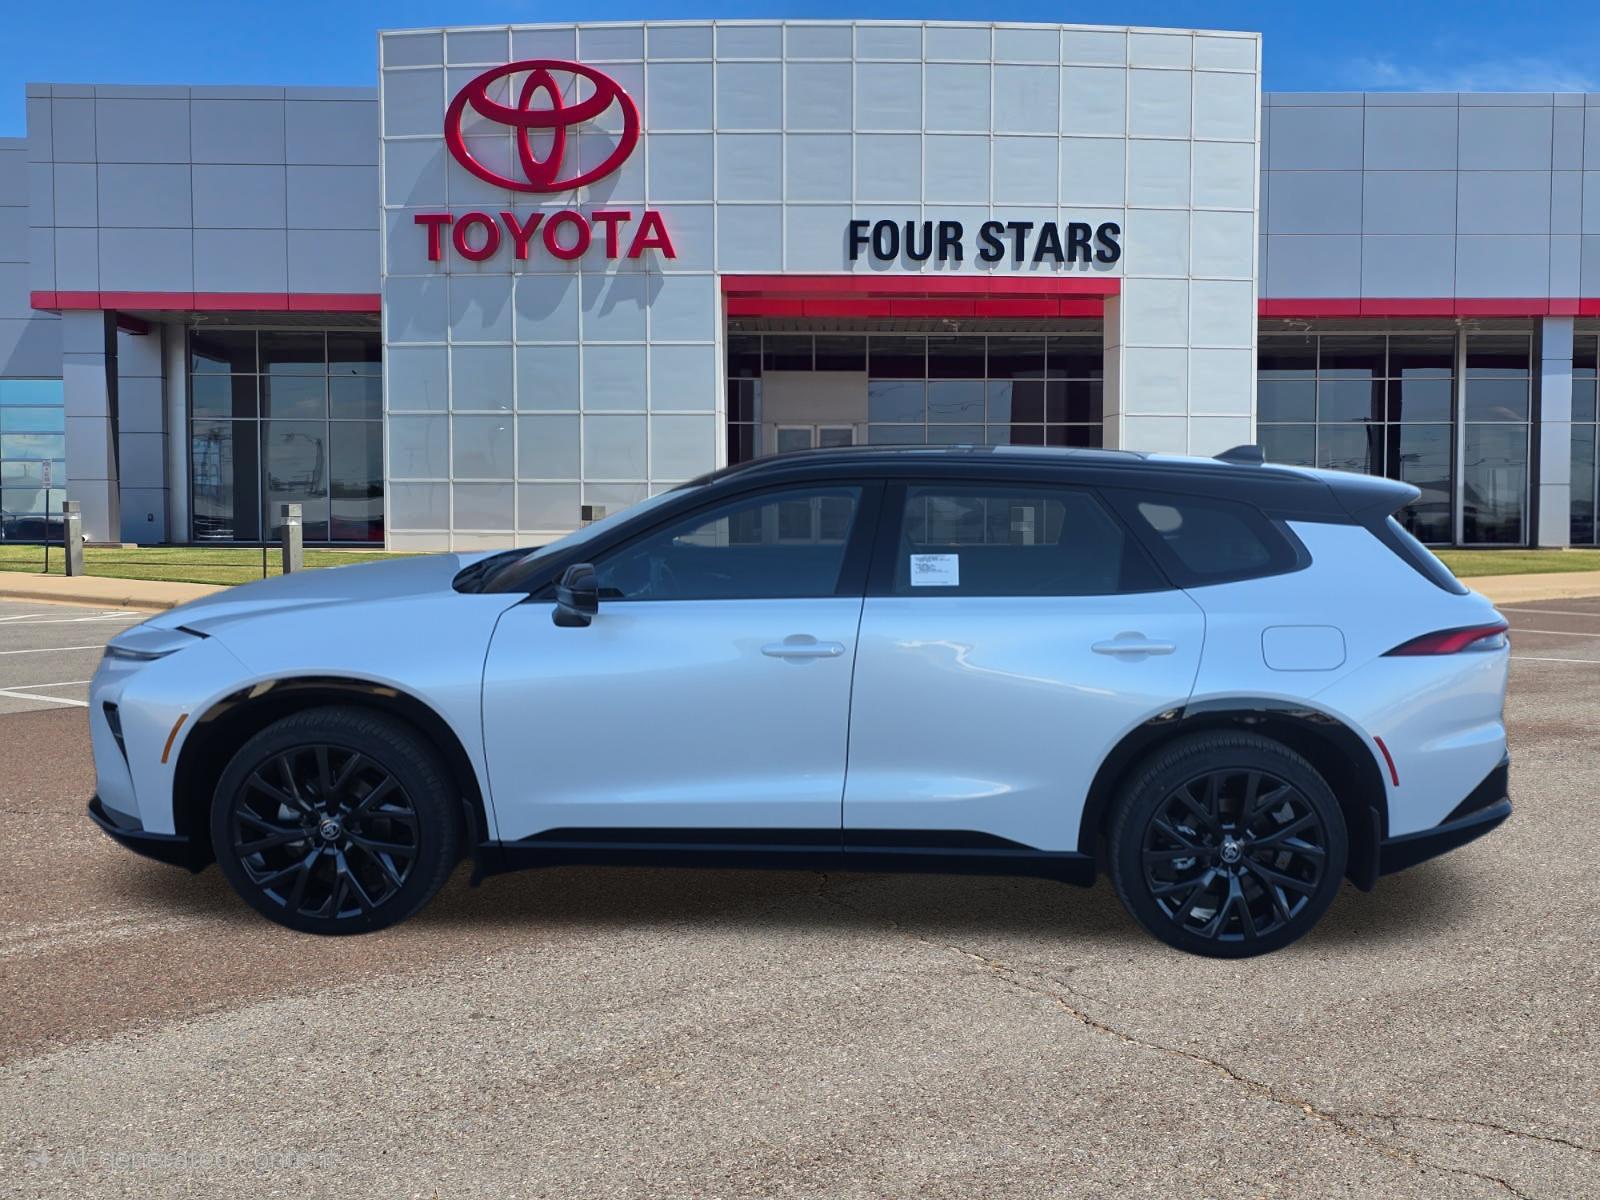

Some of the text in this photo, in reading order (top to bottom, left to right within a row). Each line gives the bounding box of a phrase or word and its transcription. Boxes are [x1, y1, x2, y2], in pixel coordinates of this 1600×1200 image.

[414, 210, 677, 262] TOYOTA
[849, 219, 1122, 264] FOUR STARS
